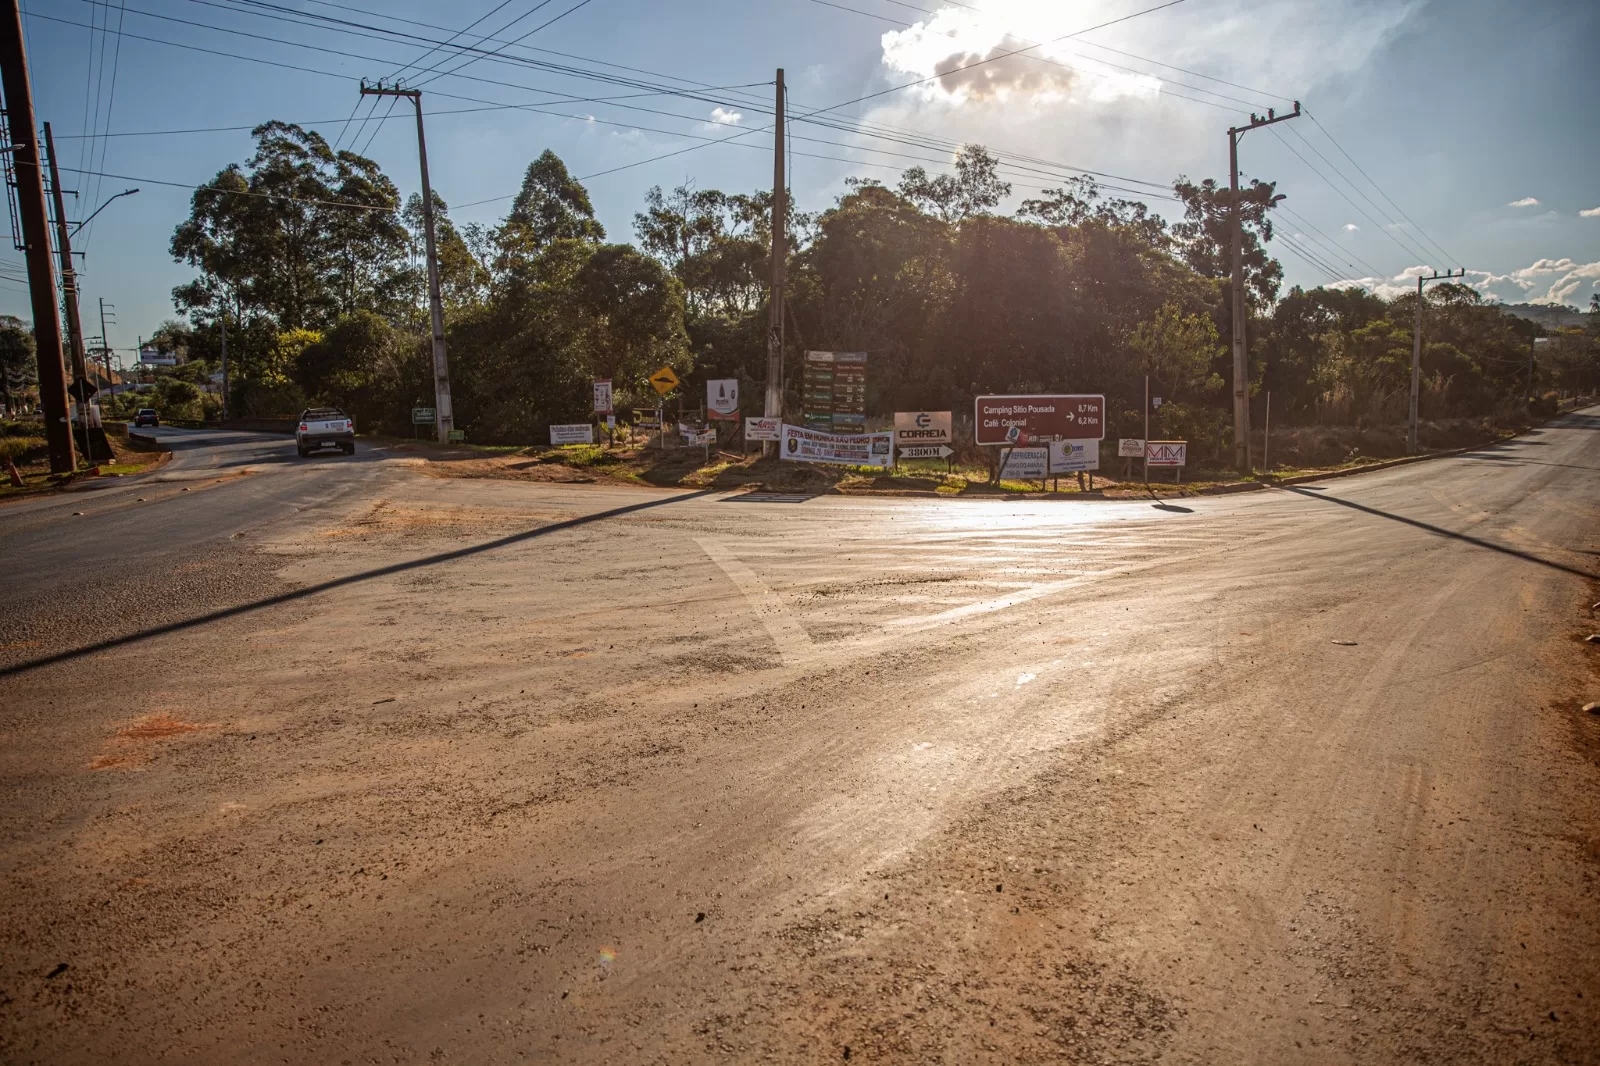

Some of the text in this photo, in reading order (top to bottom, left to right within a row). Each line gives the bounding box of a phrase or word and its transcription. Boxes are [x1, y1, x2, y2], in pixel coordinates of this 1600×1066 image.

[983, 405, 1012, 416] Camping
[1028, 405, 1055, 413] Pousada
[1078, 404, 1098, 413] 8,7 Km
[983, 418, 1027, 427] Café Colonial
[1078, 416, 1098, 425] 6,2 Km
[788, 429, 804, 438] FESTA
[849, 436, 870, 444] PEDRO
[899, 429, 947, 438] CORREIA
[908, 447, 940, 456] 3800M
[1011, 450, 1047, 460] REFRIGERAÇÃO
